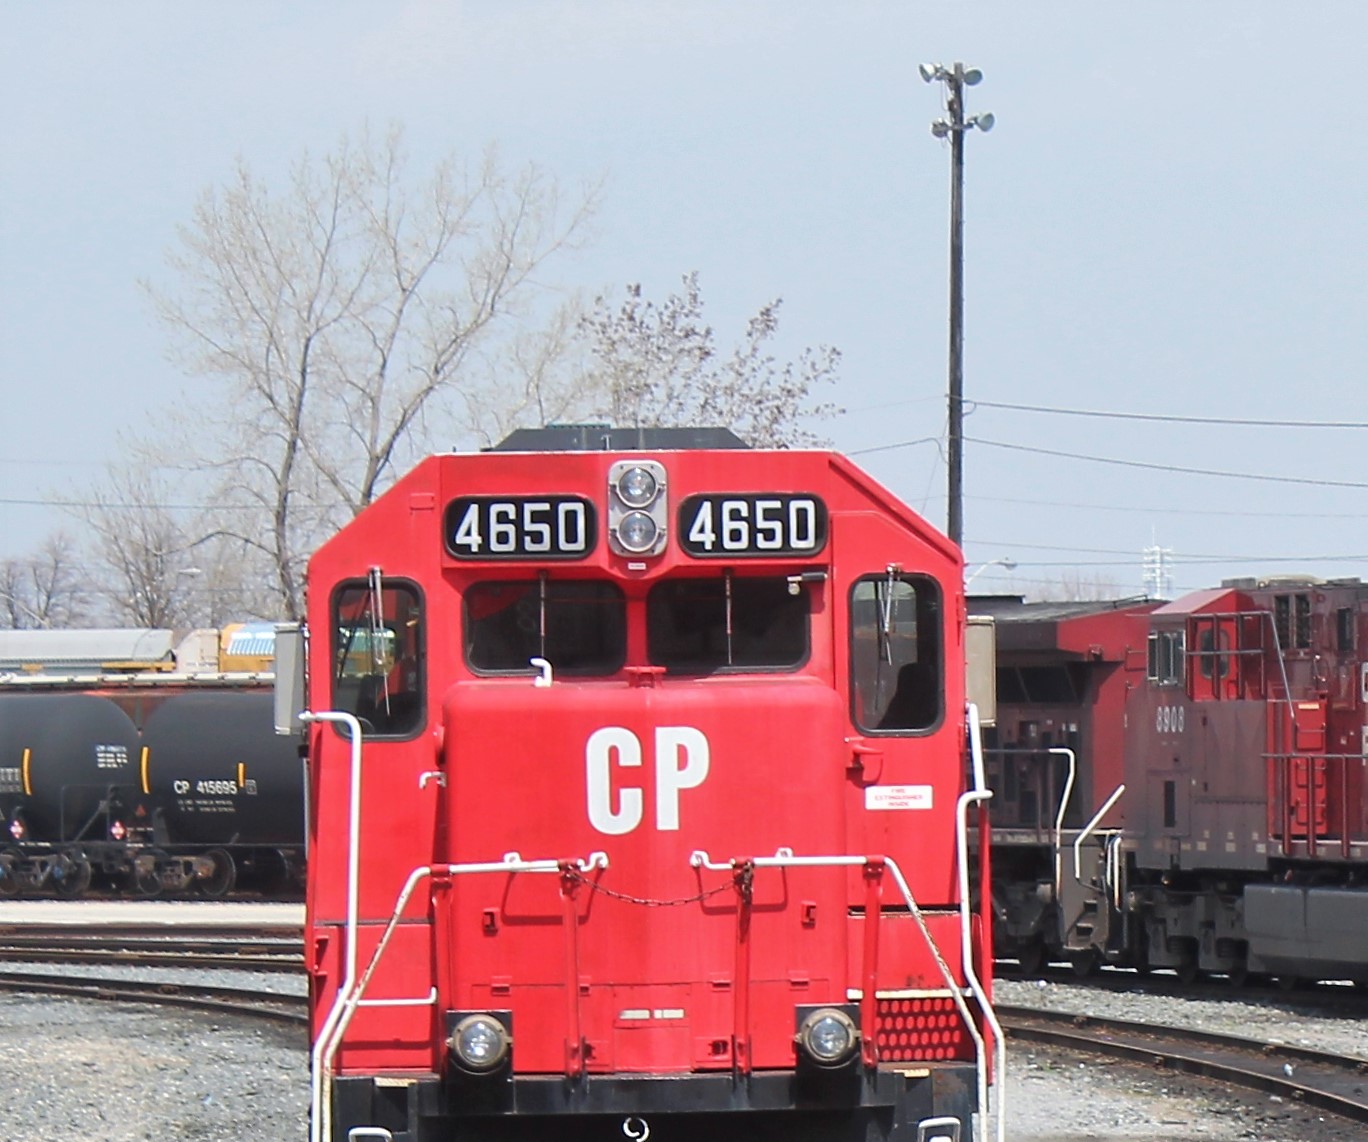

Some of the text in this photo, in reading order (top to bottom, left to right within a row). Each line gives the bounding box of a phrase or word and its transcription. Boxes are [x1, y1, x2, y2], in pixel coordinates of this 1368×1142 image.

[454, 501, 587, 553] 4650
[687, 499, 817, 551] 4650
[173, 780, 238, 795] CP 415695
[585, 725, 710, 836] CP
